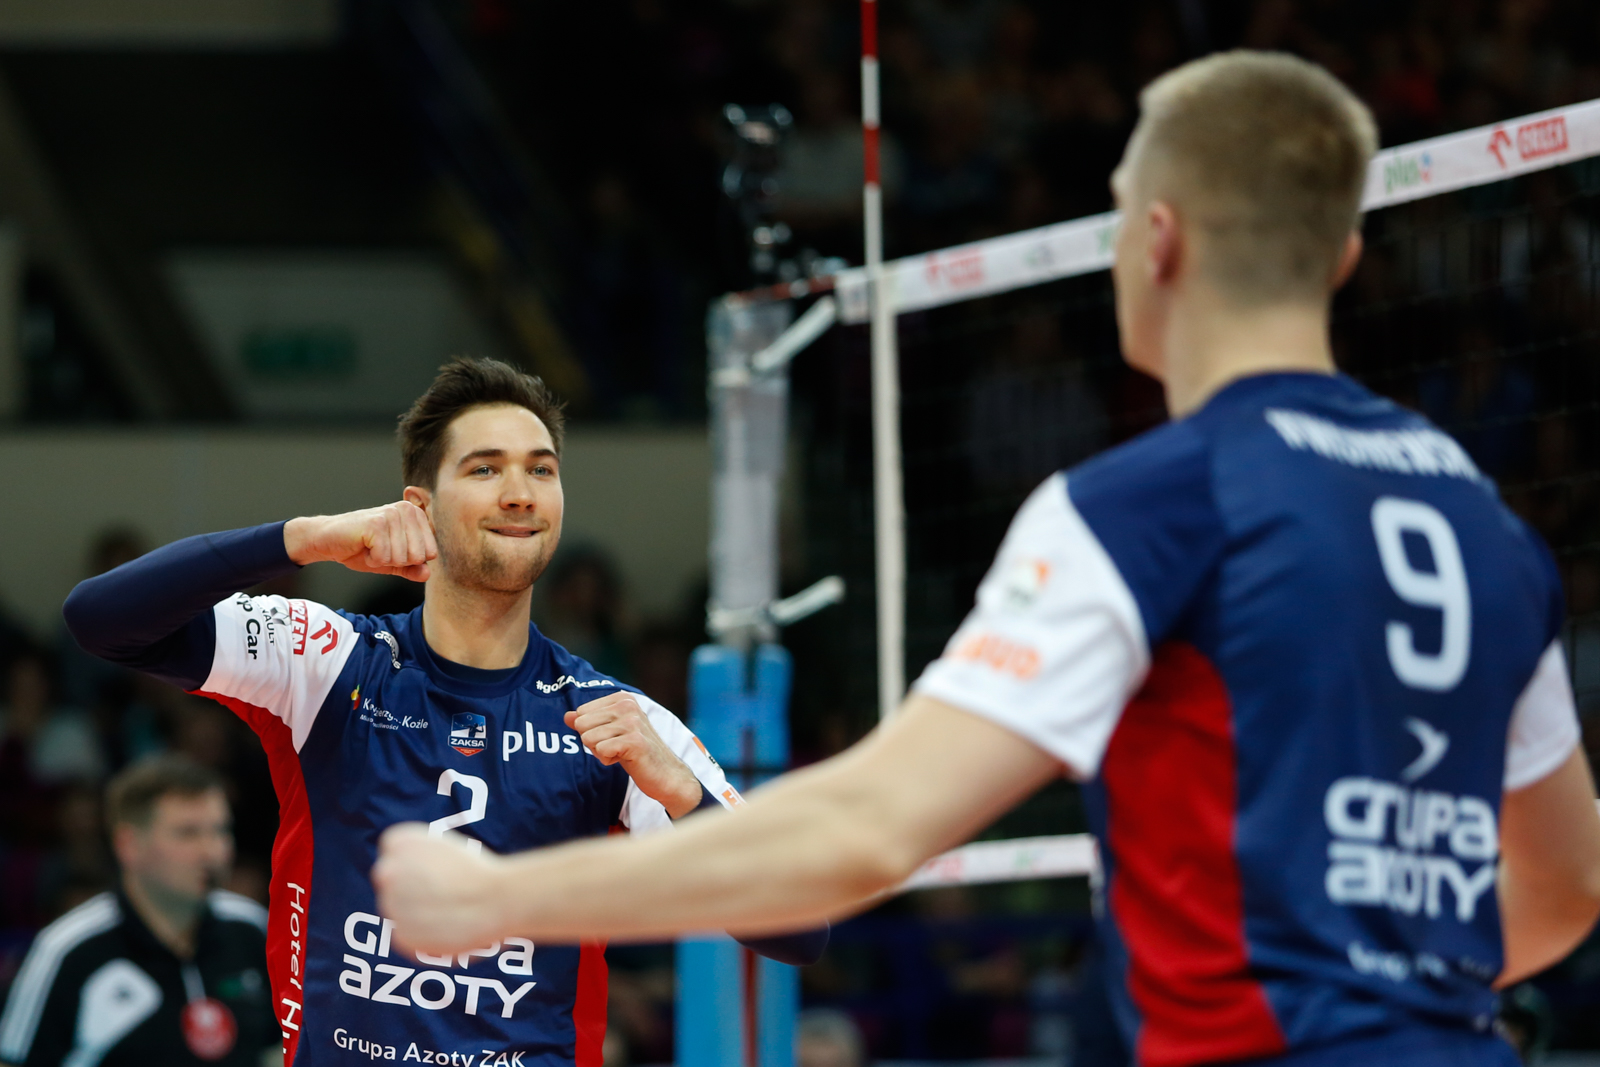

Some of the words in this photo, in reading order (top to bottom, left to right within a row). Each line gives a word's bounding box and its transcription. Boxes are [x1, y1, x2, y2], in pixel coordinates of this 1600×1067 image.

[1371, 496, 1472, 693] 9
[246, 618, 260, 660] Car
[536, 675, 615, 694] #goZAKSA
[450, 737, 485, 747] ZAKSA
[502, 720, 580, 762] plus
[427, 768, 489, 858] 2
[286, 882, 306, 991] Hotel
[333, 1027, 397, 1061] Grupa
[402, 1042, 475, 1067] Azoty
[479, 1049, 526, 1067] ZAK
